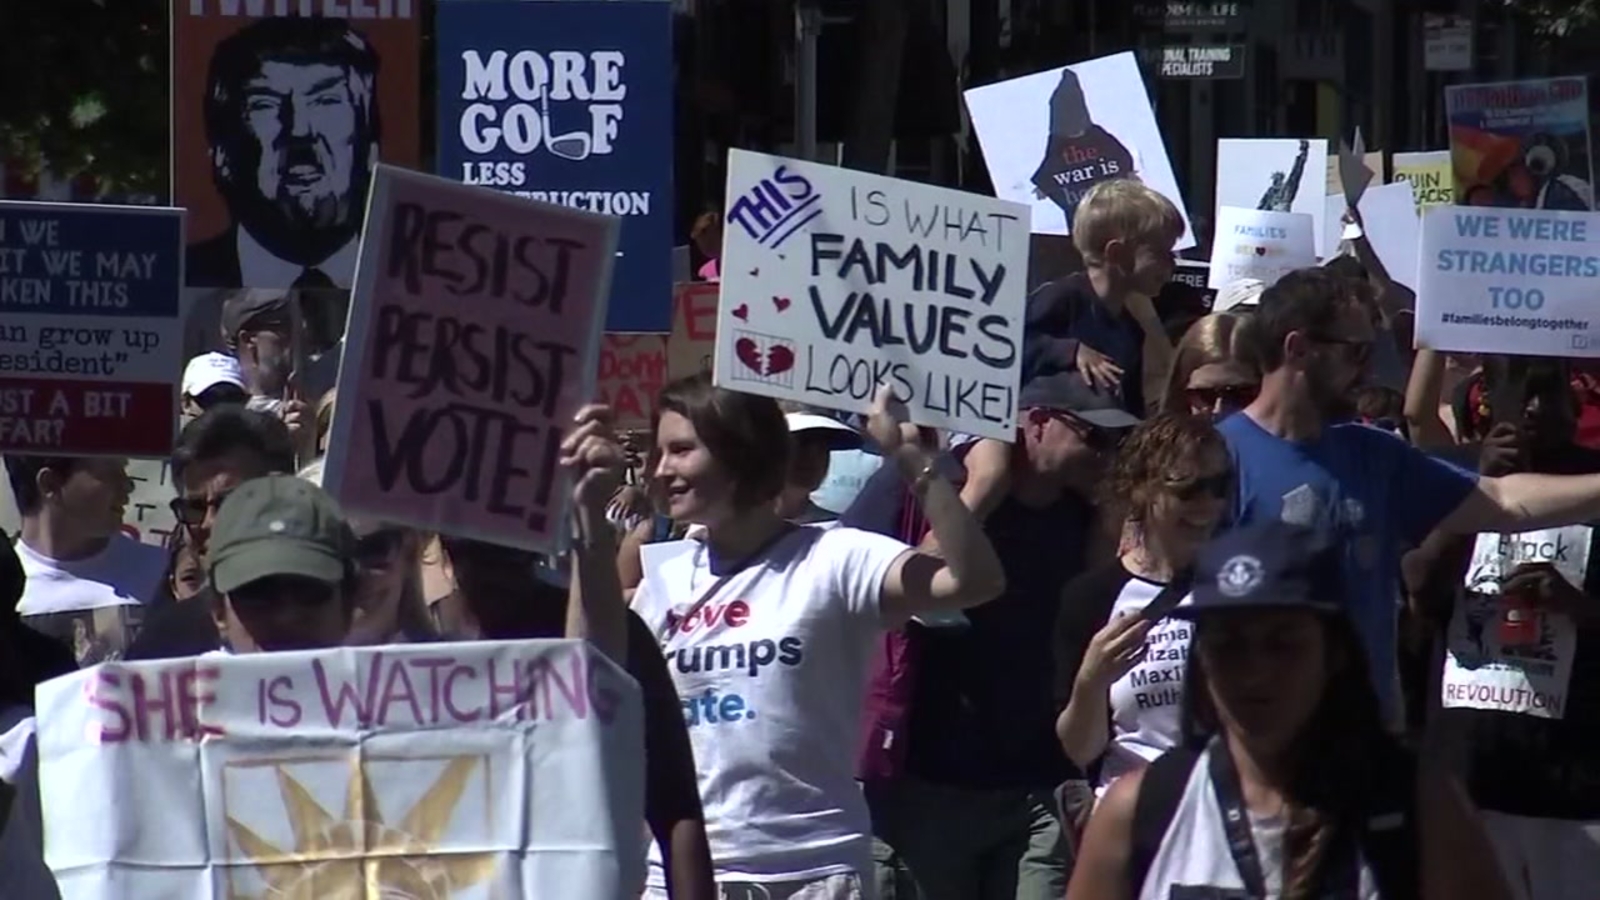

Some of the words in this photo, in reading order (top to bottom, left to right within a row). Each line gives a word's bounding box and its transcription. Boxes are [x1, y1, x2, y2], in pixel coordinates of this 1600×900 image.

[462, 50, 627, 101] MORE
[460, 103, 624, 160] GOLF
[1062, 145, 1098, 165] the
[462, 162, 526, 186] LESS
[1053, 165, 1095, 186] war
[1098, 156, 1120, 176] is
[727, 164, 813, 239] THIS
[20, 219, 60, 246] WE
[850, 186, 890, 226] IS
[905, 199, 1019, 252] WHAT
[1455, 214, 1499, 238] WE
[1507, 217, 1587, 242] WERE
[42, 249, 83, 277] WE
[96, 252, 158, 280] MAY
[388, 204, 586, 314] RESIST
[809, 233, 1007, 306] FAMILY
[1437, 249, 1600, 278] STRANGERS
[66, 281, 129, 307] THIS
[1488, 287, 1545, 311] TOO
[808, 285, 1017, 370] VALUES
[1441, 313, 1590, 330] #familiesbelongtogether
[39, 327, 114, 350] grow
[122, 330, 159, 353] up
[371, 305, 577, 418] PERSIST
[805, 345, 914, 405] LOOKS
[923, 371, 1013, 429] LIKE!
[50, 390, 71, 416] A
[84, 391, 131, 418] BIT
[366, 399, 561, 534] VOTE!
[83, 670, 225, 744] SHE
[258, 676, 301, 726] IS
[311, 651, 622, 729] WATCHING
[1446, 682, 1563, 714] REVOLUTION
